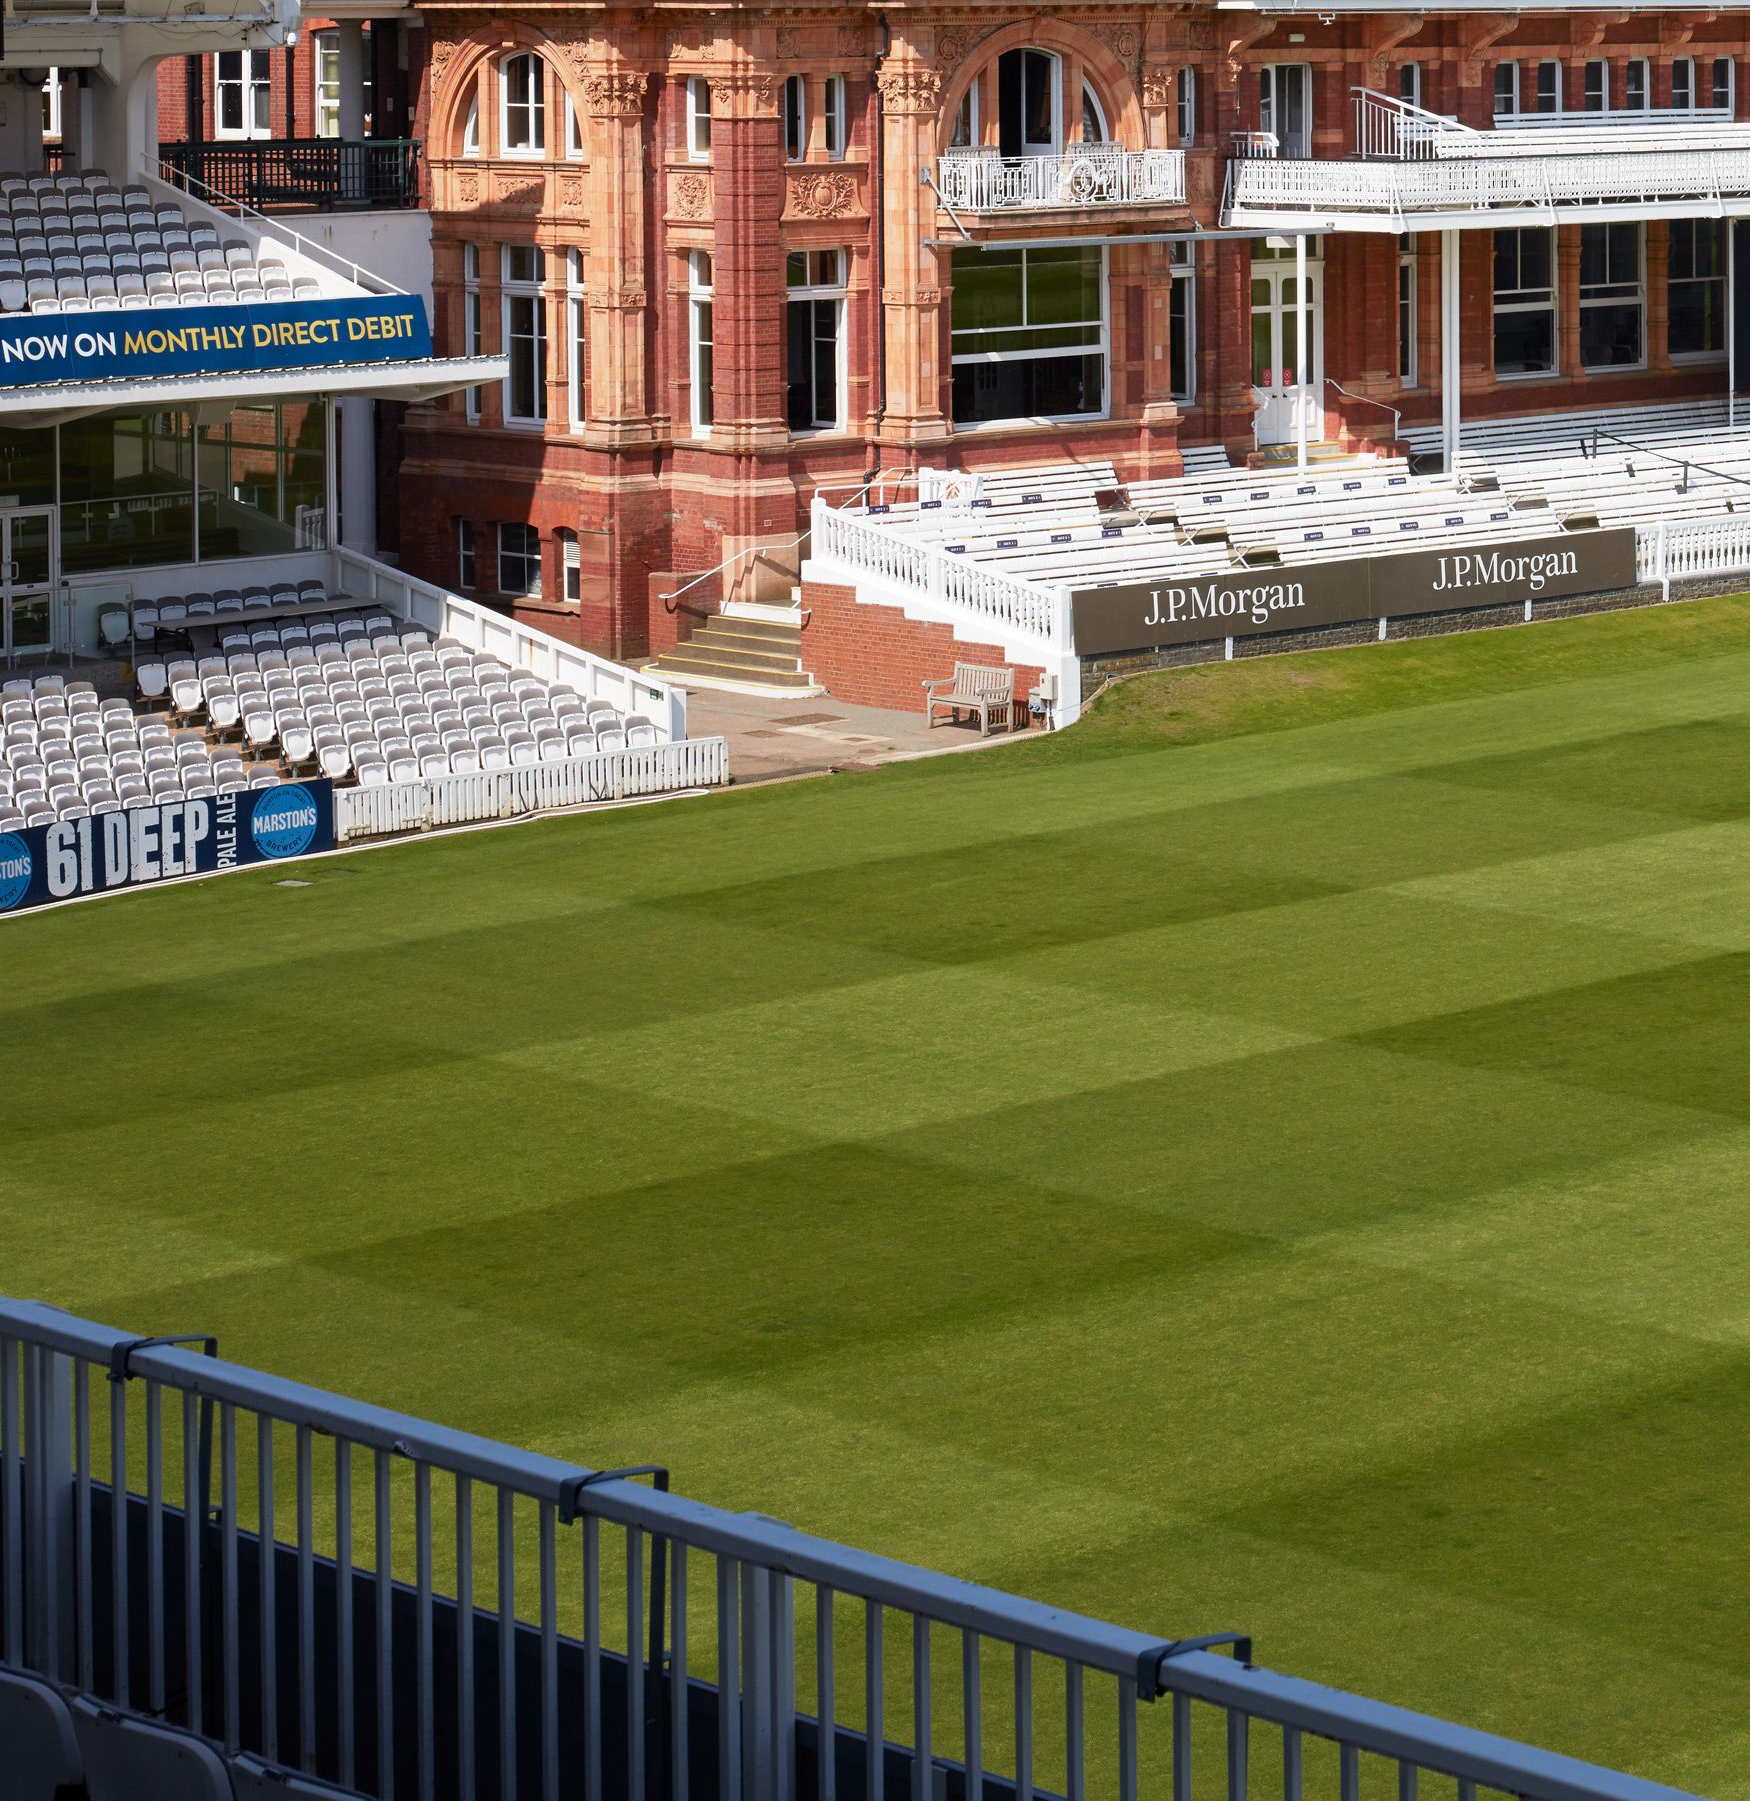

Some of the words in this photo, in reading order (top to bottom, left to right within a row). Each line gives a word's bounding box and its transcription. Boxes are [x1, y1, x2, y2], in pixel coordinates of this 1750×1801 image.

[2, 334, 69, 364] NOW
[74, 331, 118, 358] ON
[124, 325, 247, 355] MONTHLY
[253, 318, 341, 348] DIRECT
[347, 314, 415, 342] DEBIT
[1432, 551, 1579, 591] J.P.Morgan
[1144, 582, 1306, 625] J.P.Morgan
[216, 792, 236, 824] ALE
[253, 806, 317, 835] MARSTON'S
[46, 817, 94, 897] 61
[103, 800, 209, 887] DEEP
[217, 827, 237, 868] PALE
[266, 835, 303, 852] BREWERY
[0, 855, 31, 880] TON'S
